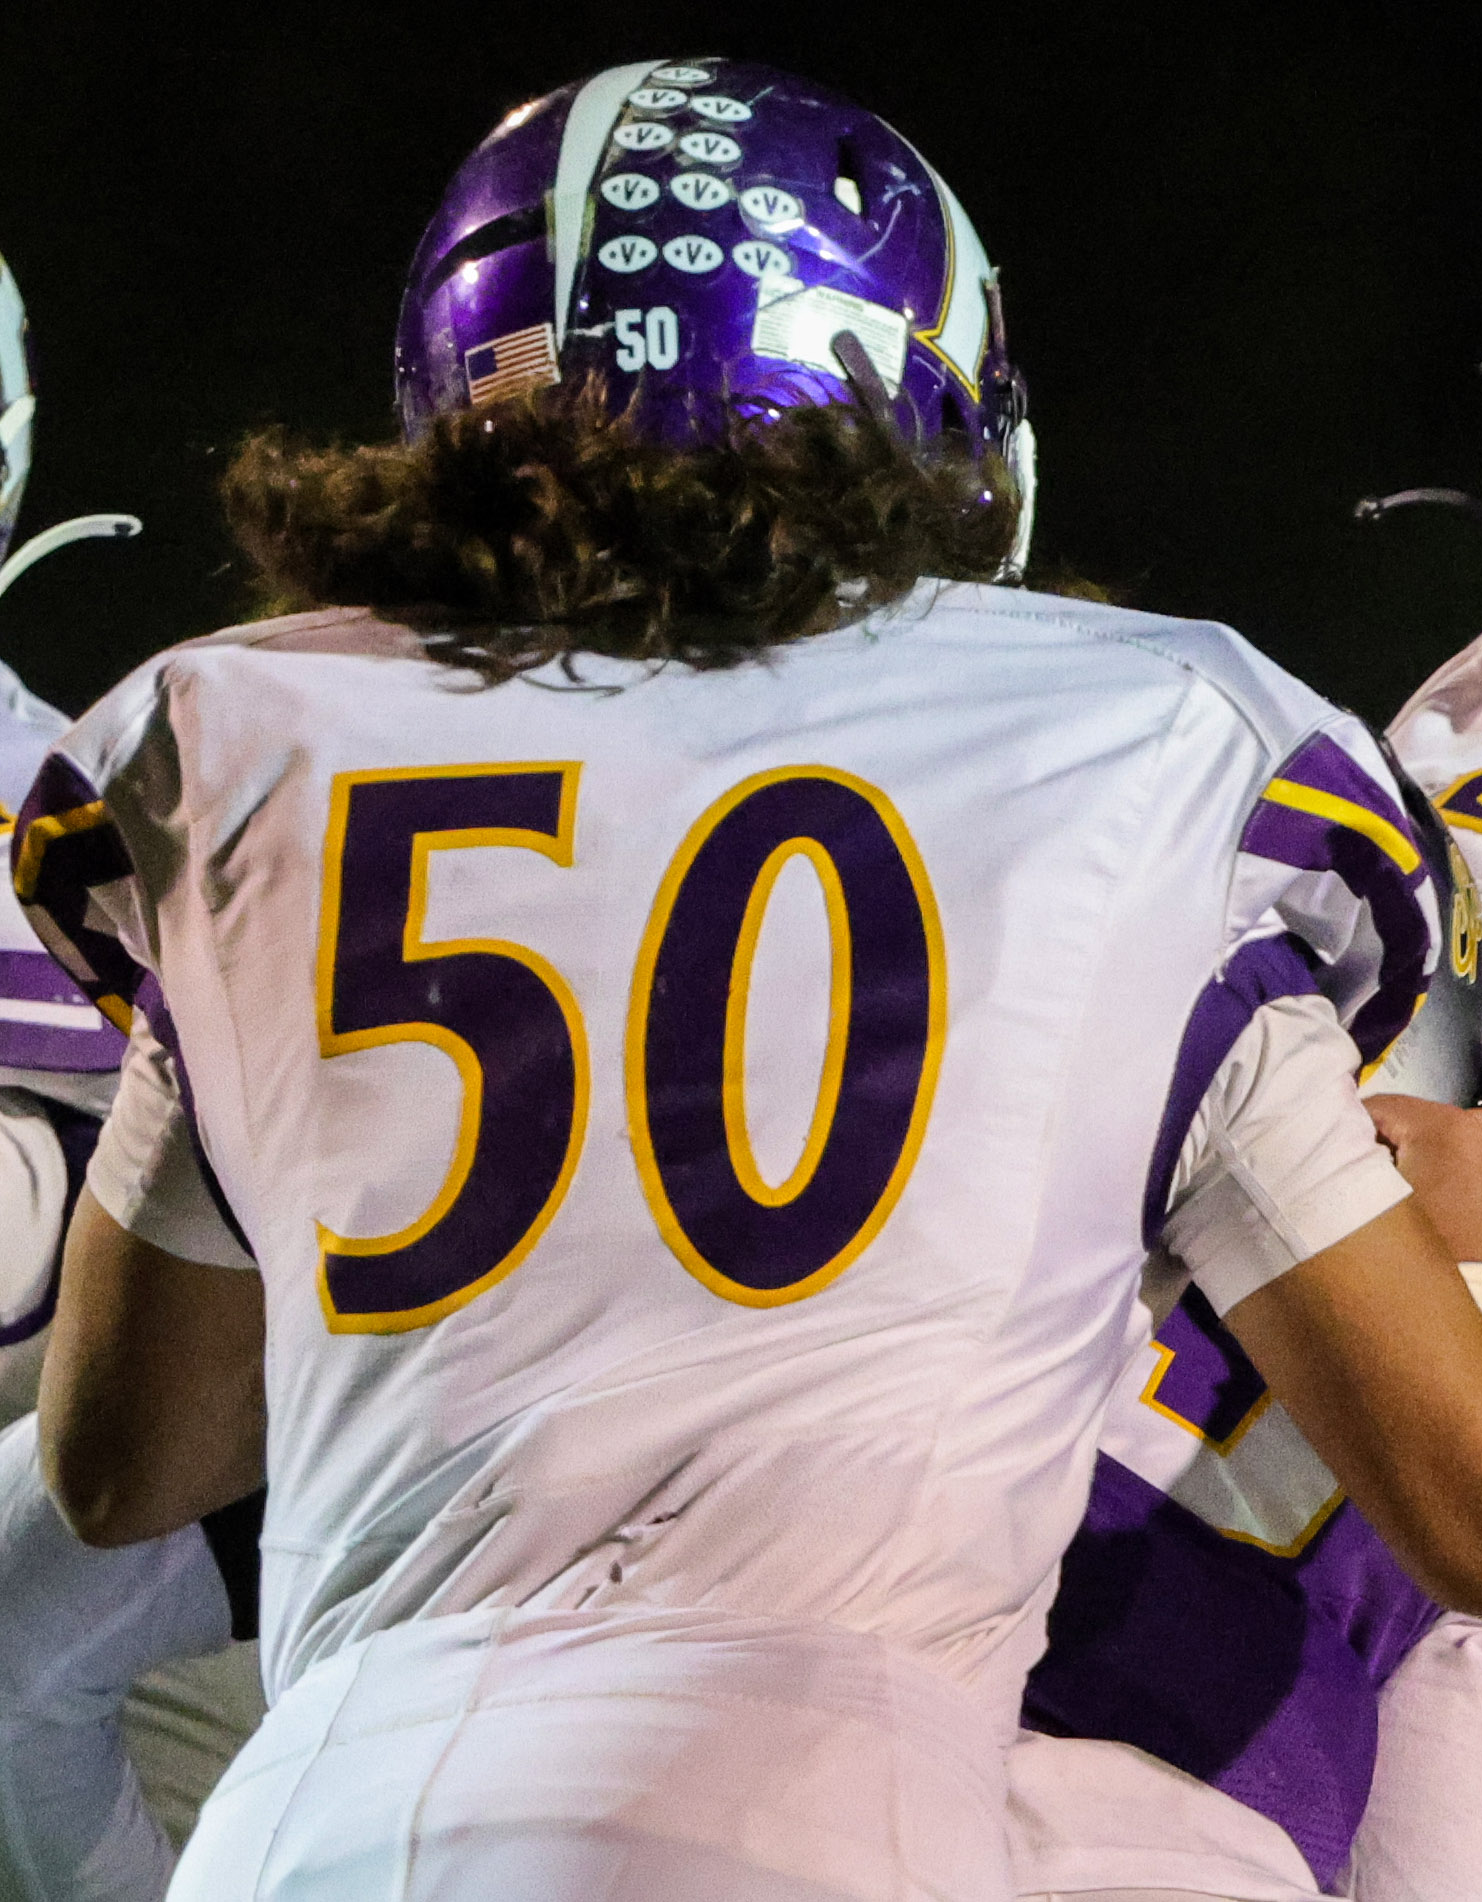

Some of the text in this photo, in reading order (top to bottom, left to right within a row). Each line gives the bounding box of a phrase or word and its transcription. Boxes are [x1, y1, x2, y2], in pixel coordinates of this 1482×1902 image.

[653, 92, 668, 104] V
[715, 102, 731, 114] V
[637, 128, 653, 143] V
[704, 138, 720, 155] V
[624, 179, 640, 202] V
[694, 178, 710, 202] V
[764, 193, 778, 215] V
[621, 242, 636, 265] V
[687, 242, 702, 265] V
[756, 248, 770, 271] V
[615, 306, 679, 372] 50
[313, 760, 948, 1334] 50
